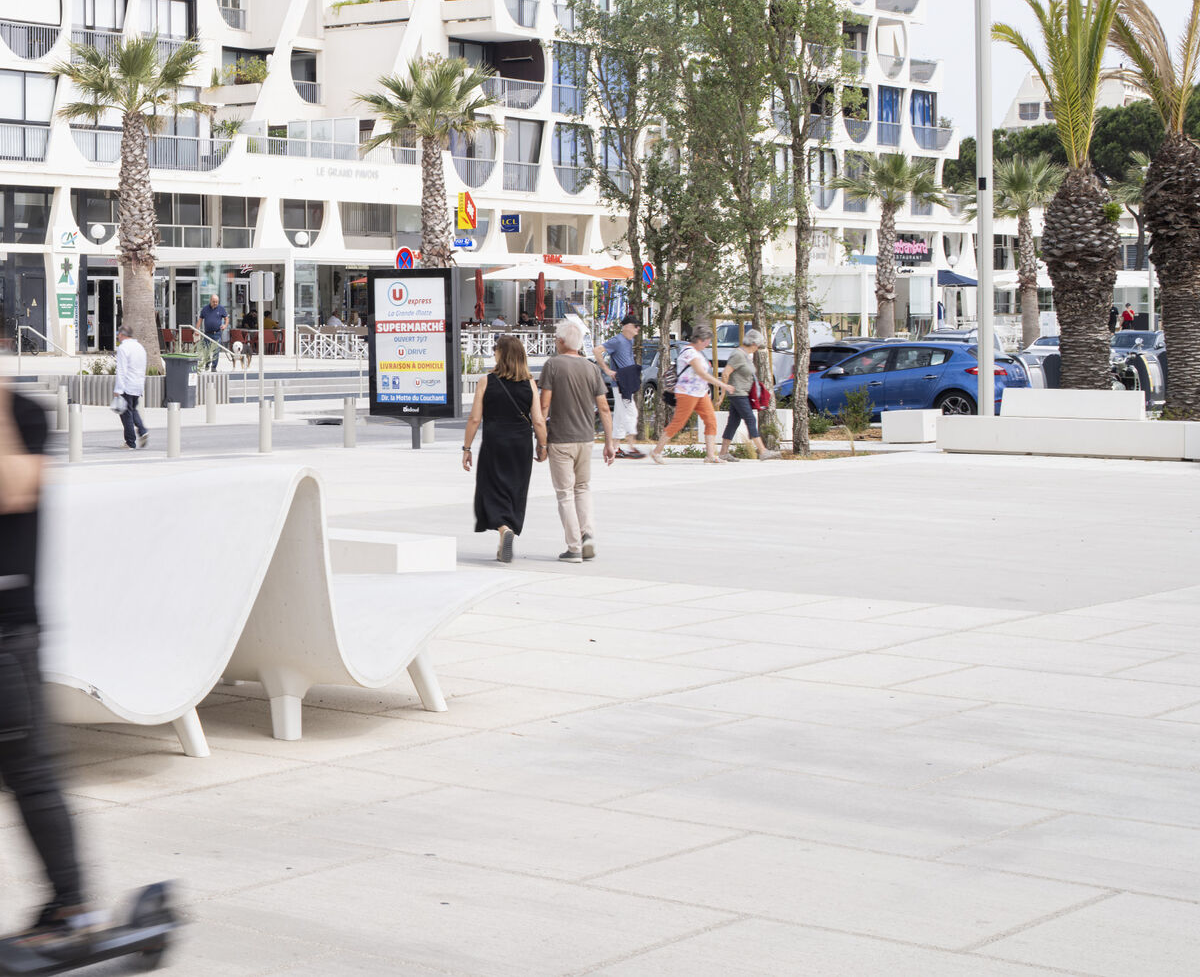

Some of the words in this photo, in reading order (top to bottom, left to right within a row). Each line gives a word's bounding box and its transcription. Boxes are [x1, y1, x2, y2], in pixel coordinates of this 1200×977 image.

[502, 218, 517, 226] LCL
[392, 288, 403, 301] U
[408, 298, 432, 306] express
[377, 320, 444, 333] SUPERMARCHÉ
[380, 362, 411, 370] LIVRAISON
